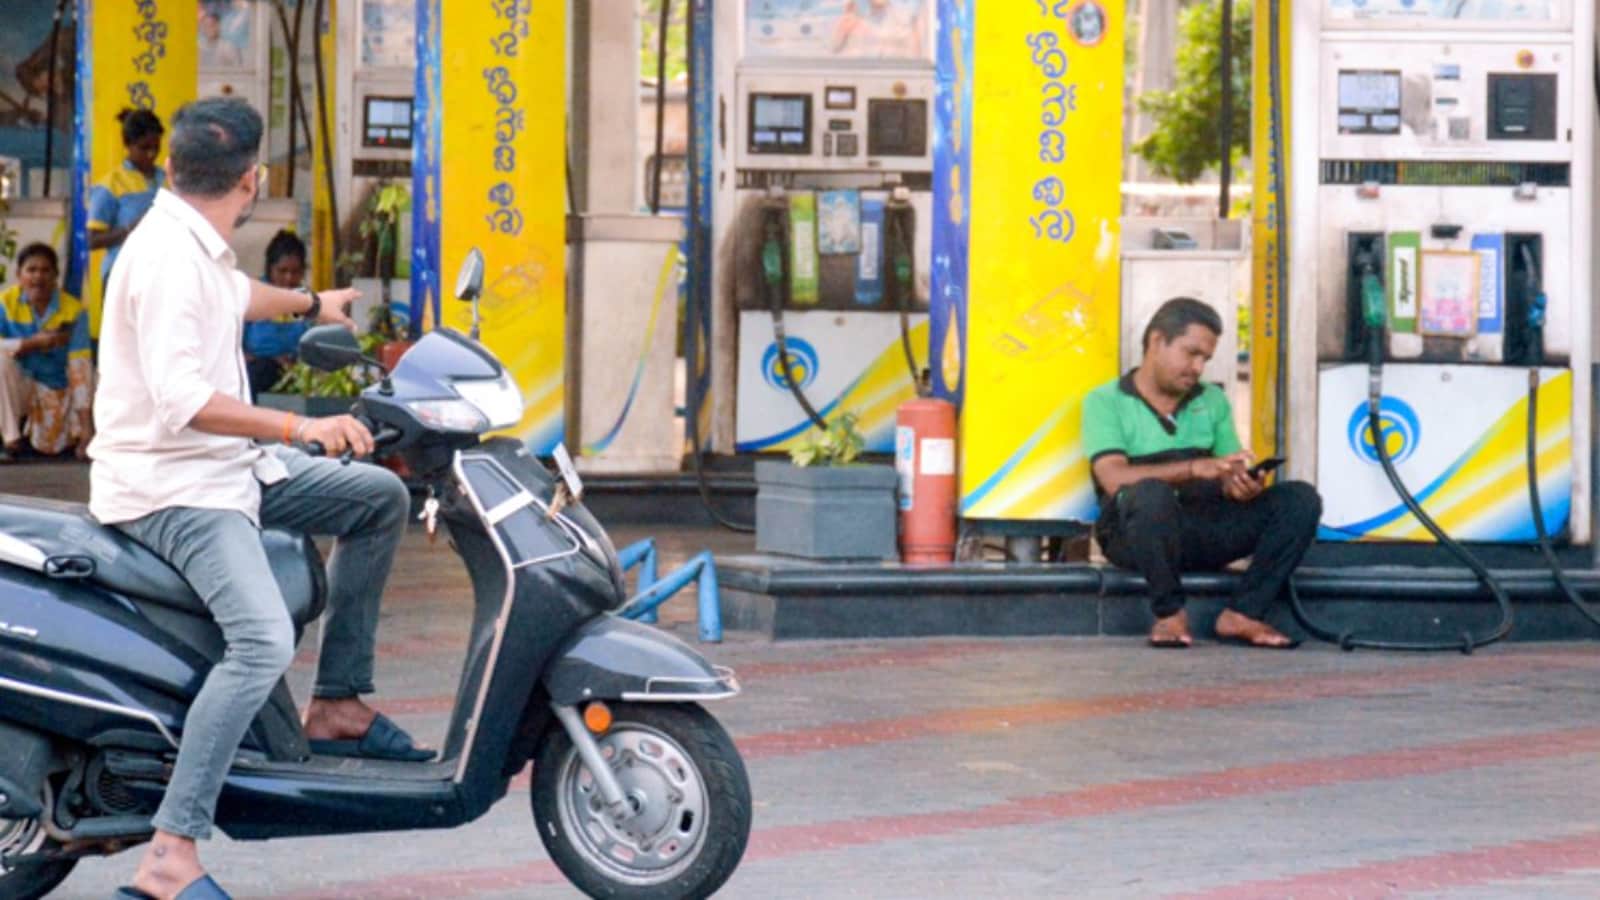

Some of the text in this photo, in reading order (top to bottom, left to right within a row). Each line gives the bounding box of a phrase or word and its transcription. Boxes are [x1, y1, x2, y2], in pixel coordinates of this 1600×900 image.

[482, 66, 525, 172] బిల్లులో
[1026, 31, 1078, 162] బిల్లులో
[484, 182, 523, 236] ప్రతి
[1029, 177, 1075, 242] ప్రతి
